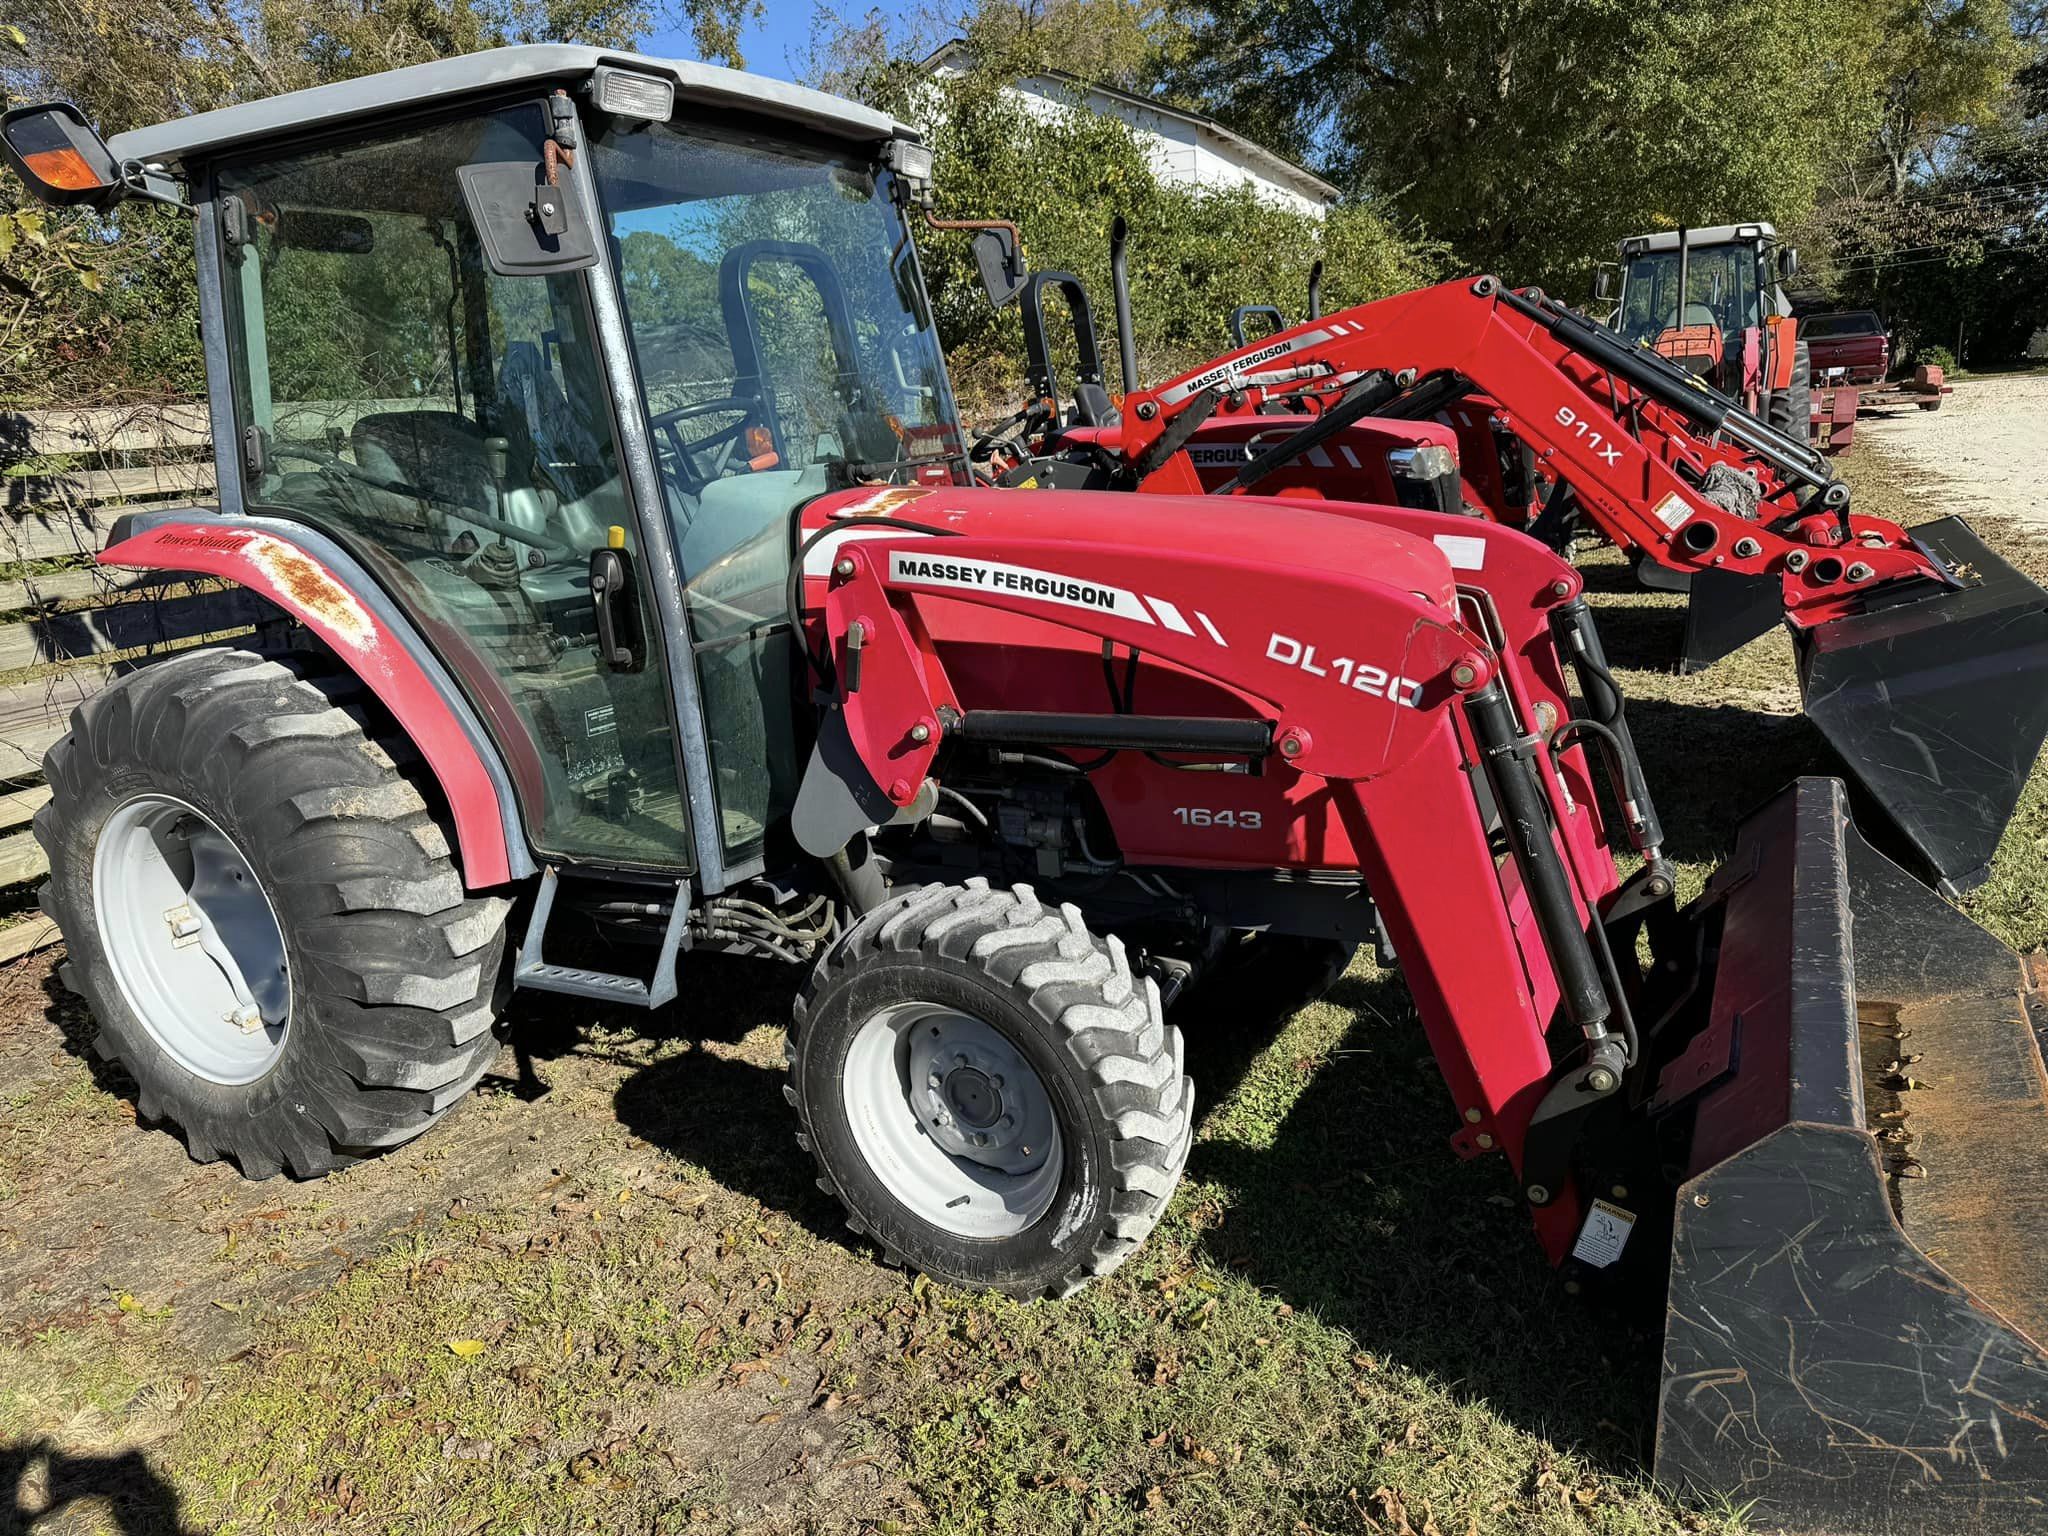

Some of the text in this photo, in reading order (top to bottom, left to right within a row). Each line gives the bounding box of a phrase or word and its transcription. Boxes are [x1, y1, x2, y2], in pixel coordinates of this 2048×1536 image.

[1232, 341, 1292, 372] FERGUSON
[1555, 406, 1624, 467] 911X
[898, 560, 1116, 609] MASSEY FERGUSON
[1265, 631, 1424, 709] DL120
[1172, 807, 1263, 830] 1643
